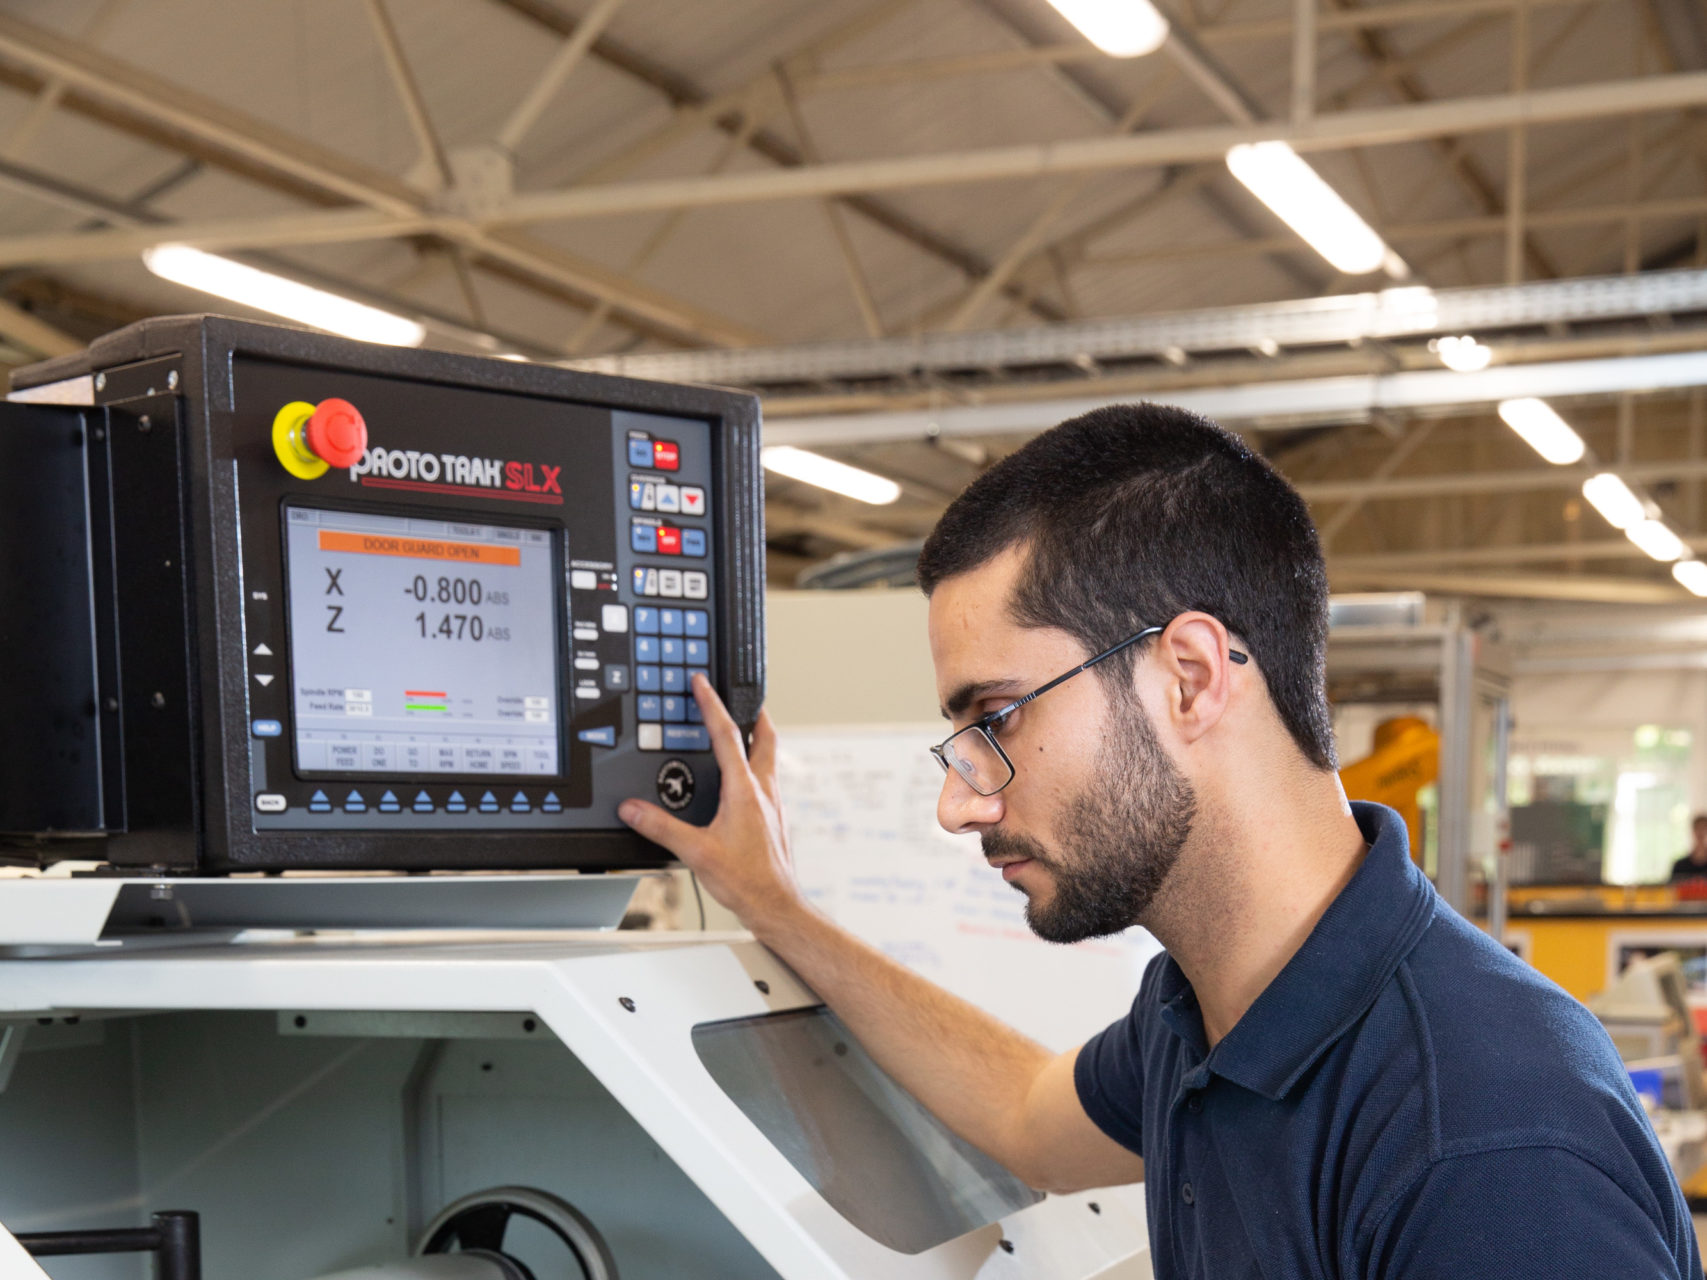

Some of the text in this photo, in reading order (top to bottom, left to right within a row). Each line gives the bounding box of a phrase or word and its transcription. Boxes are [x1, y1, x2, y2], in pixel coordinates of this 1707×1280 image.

[350, 447, 440, 482] PROTO
[505, 461, 562, 494] SLX
[364, 538, 480, 560] DOOR GUARD OPEN
[324, 567, 511, 606] X -0.800 ABS
[326, 605, 512, 641] Z 1.470 ABS
[638, 610, 648, 623] 7
[663, 611, 673, 625] 8
[640, 641, 649, 652] 4
[642, 670, 649, 681] 1
[665, 670, 674, 683] 2
[310, 702, 326, 711] Feed
[328, 703, 344, 712] Rate
